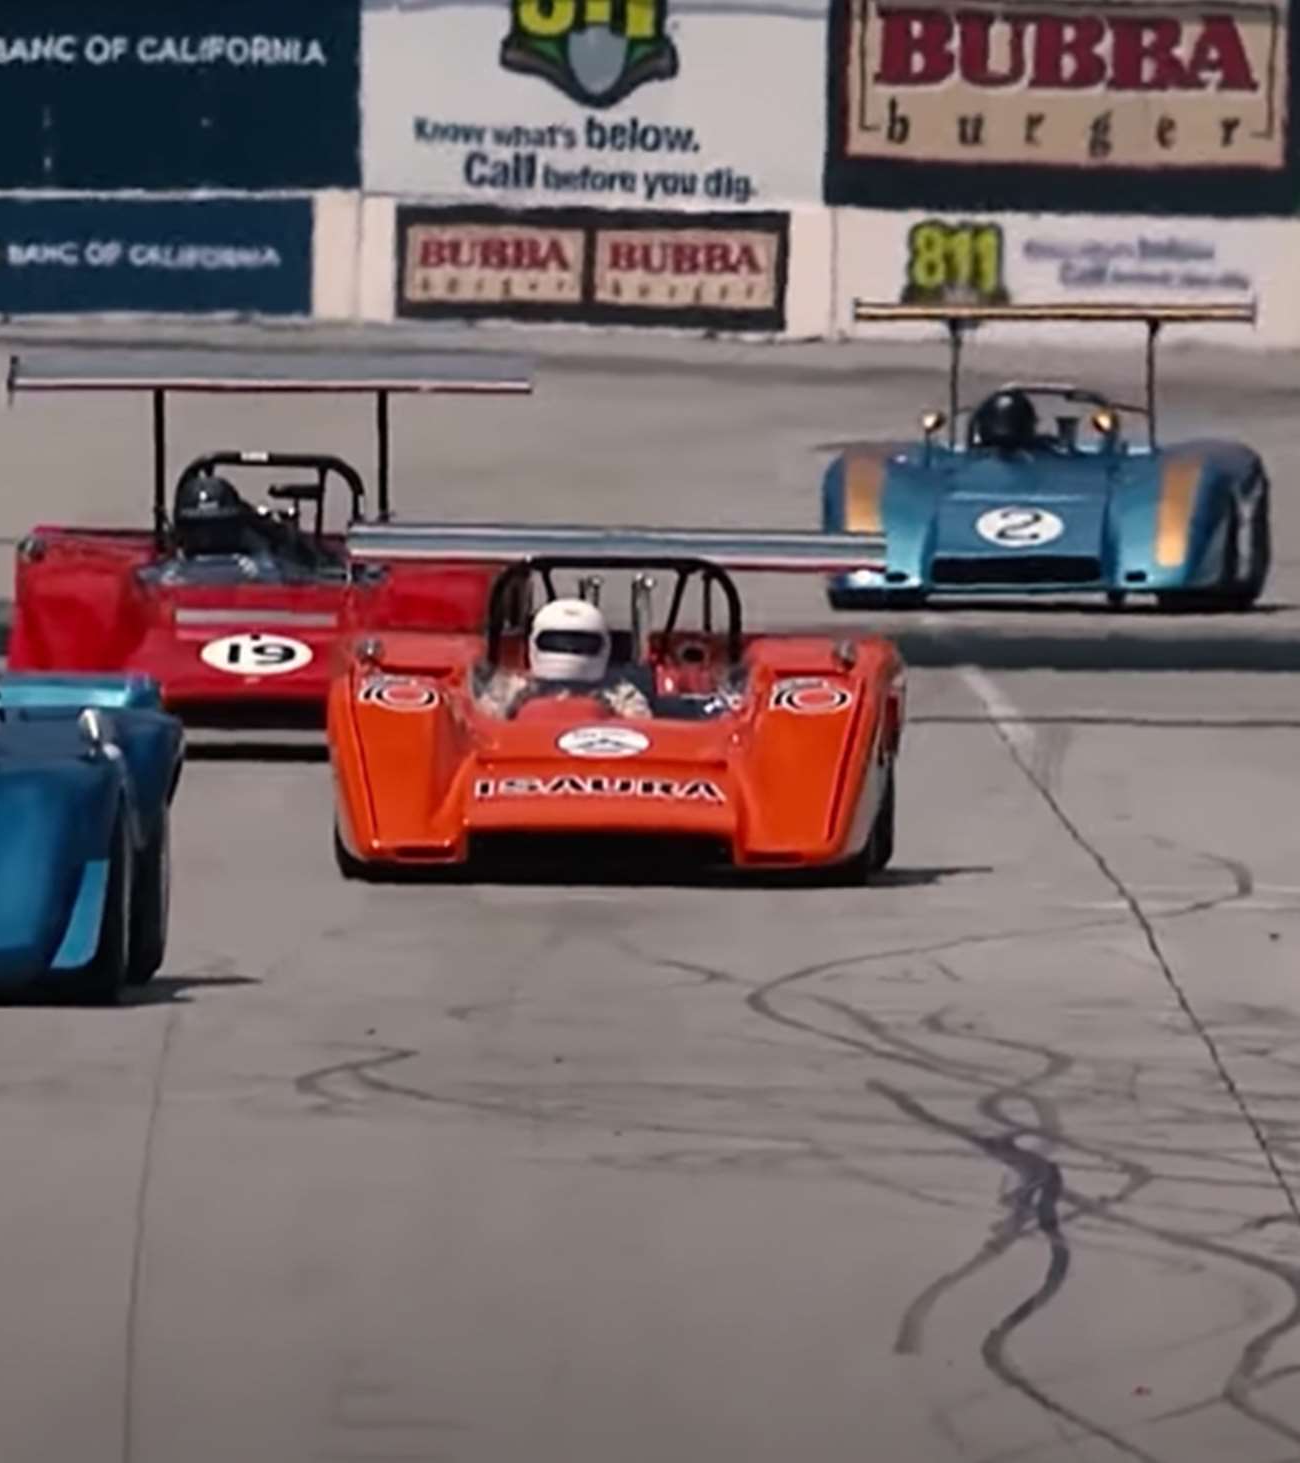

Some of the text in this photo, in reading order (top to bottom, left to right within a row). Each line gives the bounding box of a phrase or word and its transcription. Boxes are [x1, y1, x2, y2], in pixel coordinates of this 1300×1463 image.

[84, 37, 129, 62] OF
[137, 37, 327, 66] CALIFORNIA
[874, 8, 1258, 92] BUBBA
[414, 116, 700, 153] Know what's below.
[887, 97, 1240, 157] burger
[464, 152, 756, 203] Call before you dig.
[419, 238, 763, 275] BUBBA BUBBA
[913, 225, 1000, 292] 811
[996, 511, 1042, 539] 2
[227, 643, 297, 665] 19
[474, 776, 728, 803] ISAURA
